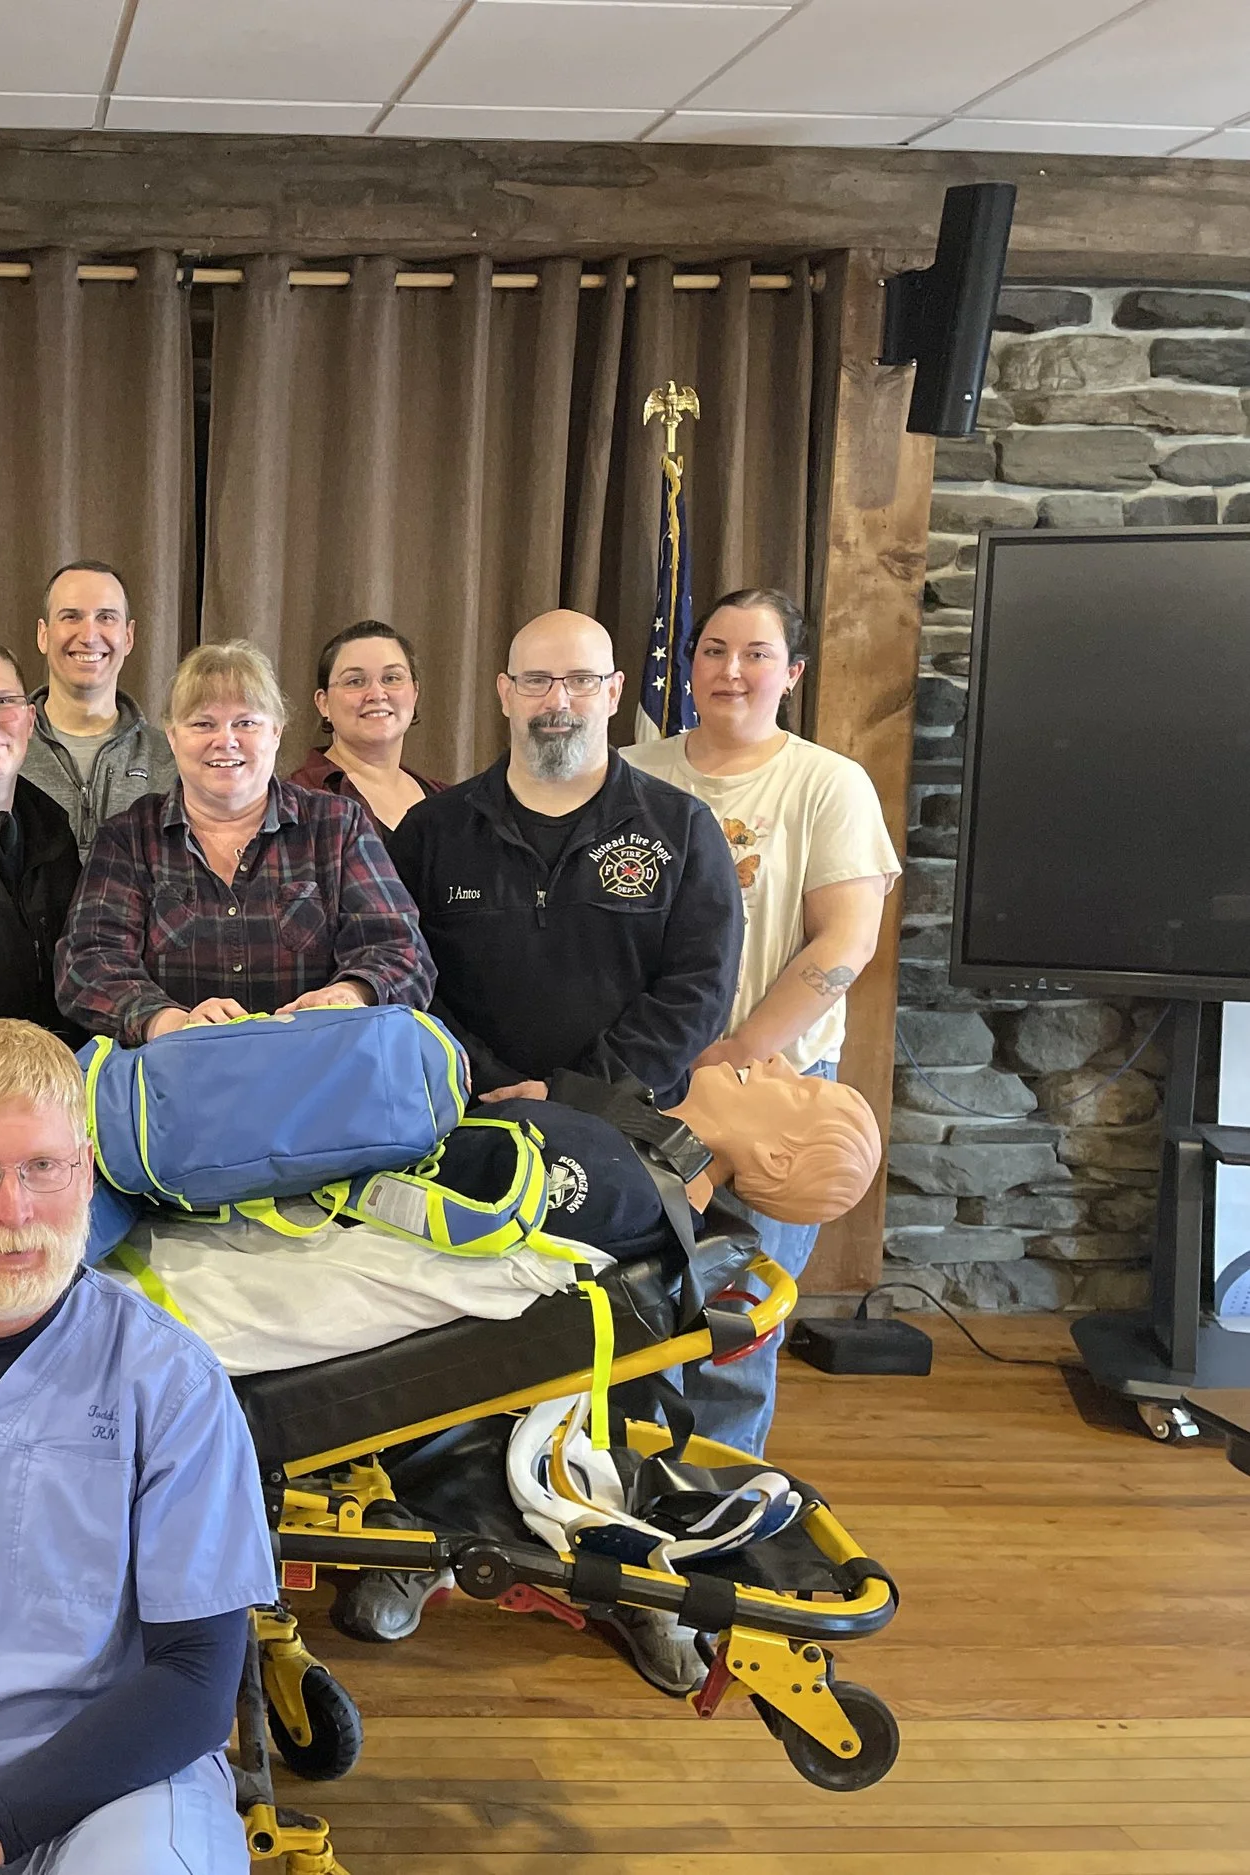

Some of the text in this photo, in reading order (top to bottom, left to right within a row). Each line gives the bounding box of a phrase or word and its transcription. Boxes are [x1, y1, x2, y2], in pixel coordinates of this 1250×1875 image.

[588, 833, 673, 865] Alstead Fire Dept
[620, 850, 642, 858] FIRE
[604, 864, 614, 876] F
[645, 867, 654, 880] D
[455, 885, 481, 900] Antos
[558, 1155, 589, 1214] ROBERGE EMS
[87, 1404, 114, 1421] Todd
[92, 1425, 120, 1441] RN
